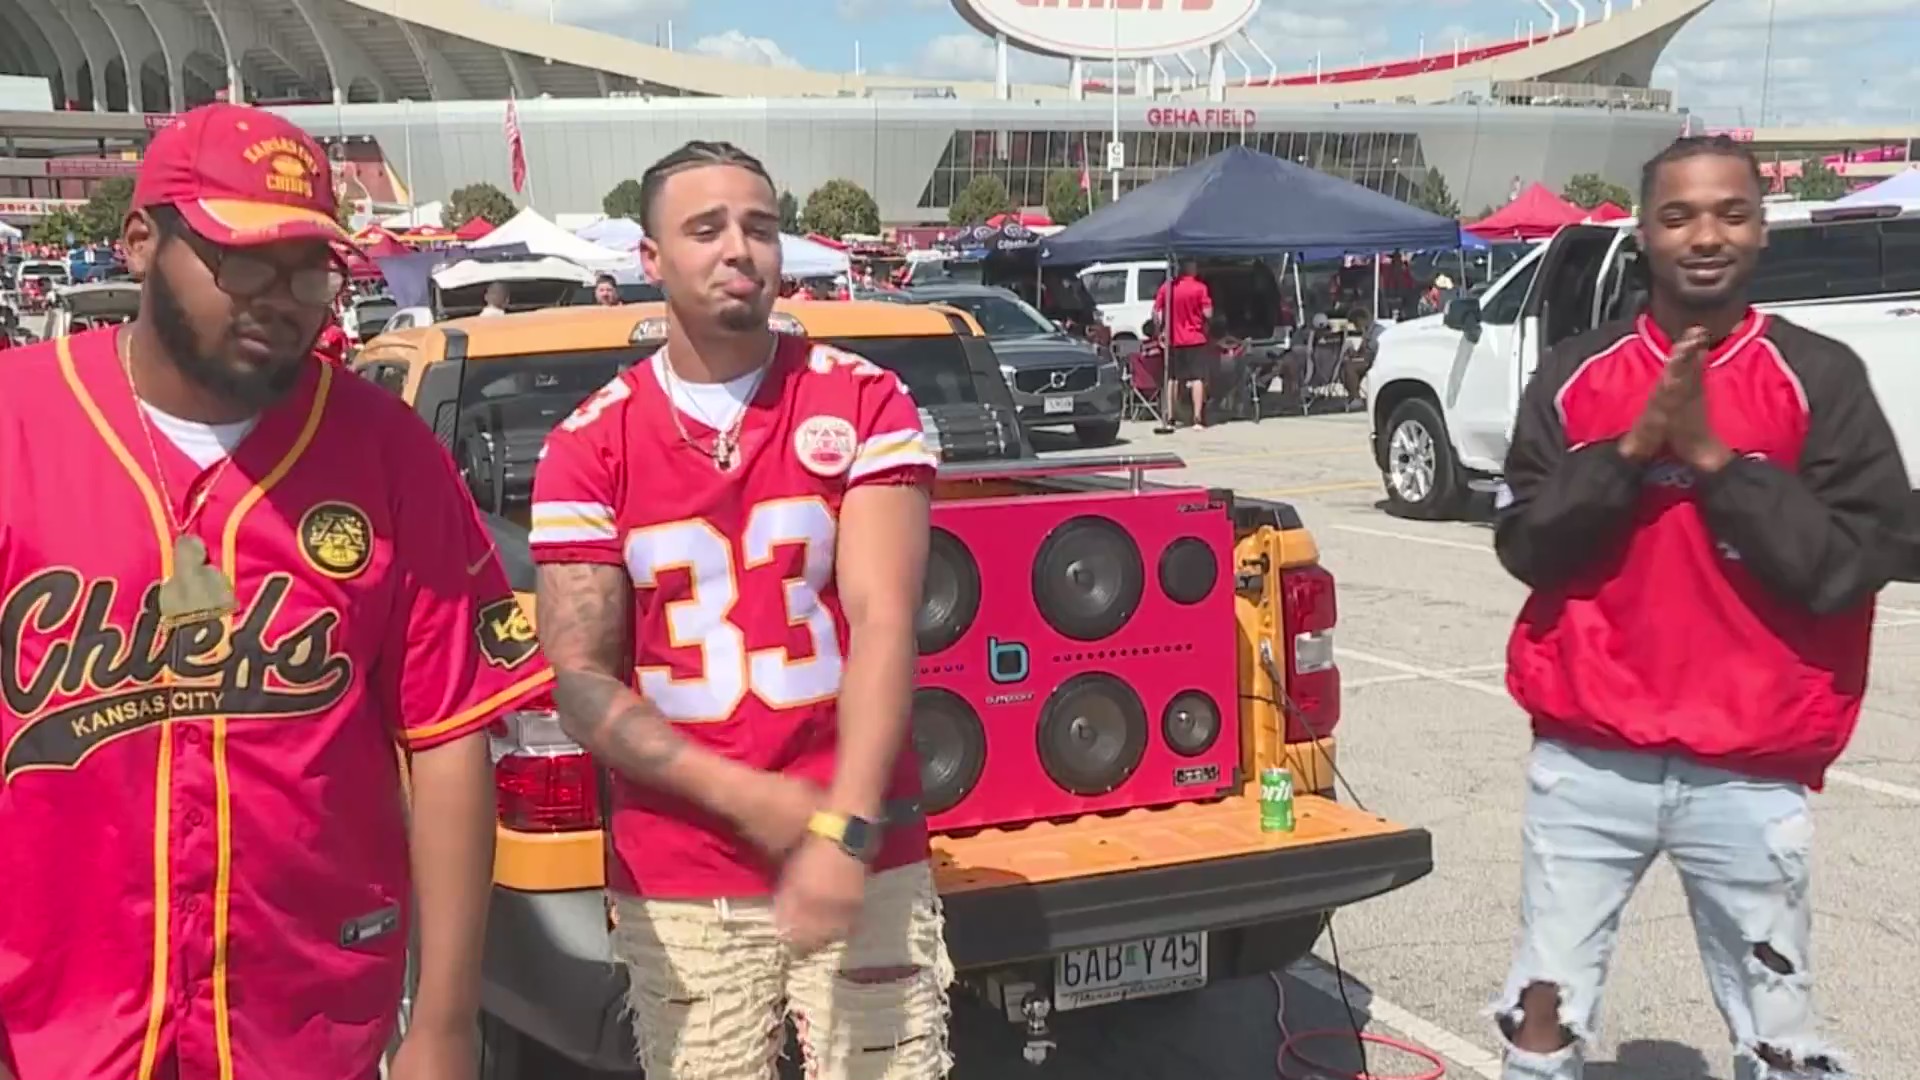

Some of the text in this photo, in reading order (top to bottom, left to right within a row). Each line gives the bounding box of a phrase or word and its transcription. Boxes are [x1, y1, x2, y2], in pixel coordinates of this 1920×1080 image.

[1147, 109, 1256, 128] GEHA FIELD
[623, 495, 843, 723] 33
[0, 566, 345, 718] Chiefs
[71, 691, 224, 737] KANSAS CITY
[1064, 935, 1198, 987] 6AB Y45
